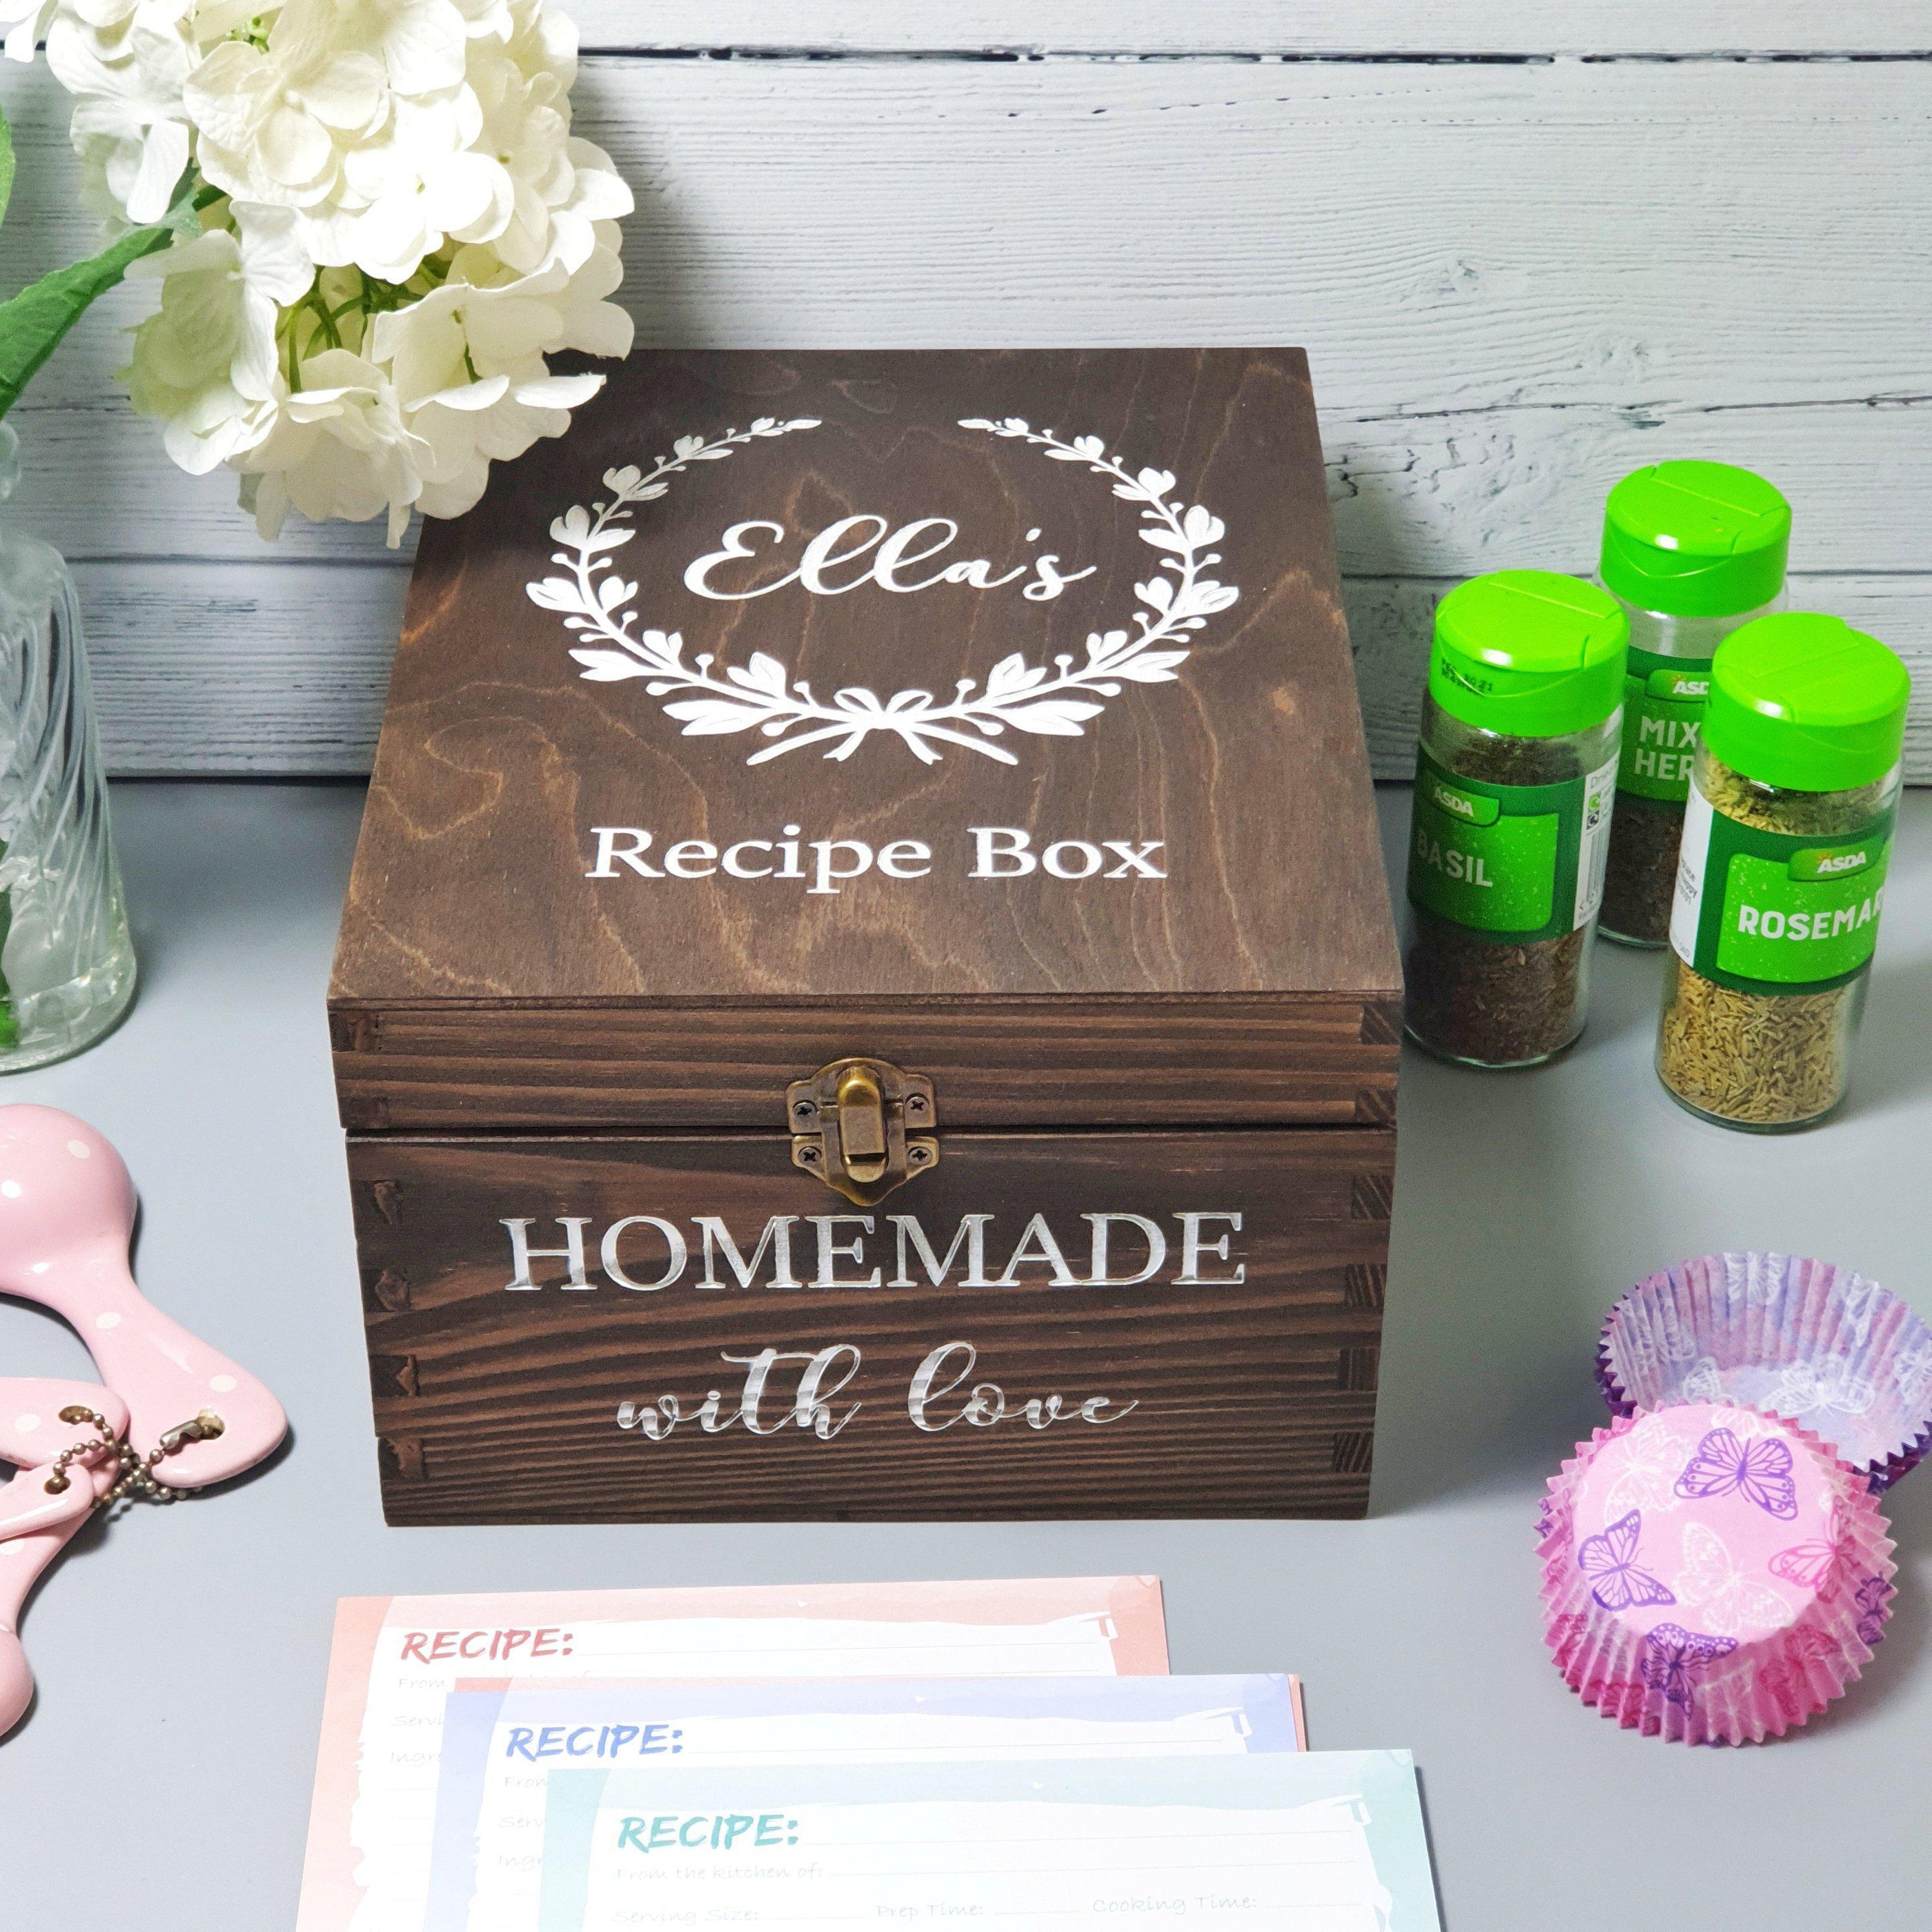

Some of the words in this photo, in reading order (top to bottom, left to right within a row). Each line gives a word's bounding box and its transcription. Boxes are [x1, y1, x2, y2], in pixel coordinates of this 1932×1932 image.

[683, 514, 1097, 602] Ella's
[1639, 716, 1701, 748] MIX
[1434, 787, 1473, 816] ASDA
[585, 823, 931, 894] Recipe
[967, 827, 1167, 880] Box
[1418, 829, 1493, 887] BASIL
[1817, 851, 1866, 873] ASDA
[499, 1211, 1245, 1290] HOMEMADE
[617, 1343, 862, 1441] with
[908, 1340, 1139, 1432] love
[401, 1628, 573, 1664] RECIPE:
[397, 1678, 448, 1689] From
[506, 1724, 682, 1762] RECIPE:
[618, 1813, 799, 1853] RECIPE:
[615, 1866, 669, 1880] From
[676, 1865, 707, 1880] the
[712, 1863, 791, 1880] kitchen
[797, 1862, 823, 1882] of:
[612, 1907, 697, 1926] Serving
[704, 1906, 759, 1922] Size:
[874, 1905, 918, 1922] Prep
[925, 1901, 983, 1917] Time:
[1092, 1895, 1186, 1915] Cooking
[1194, 1893, 1257, 1910] Time:
